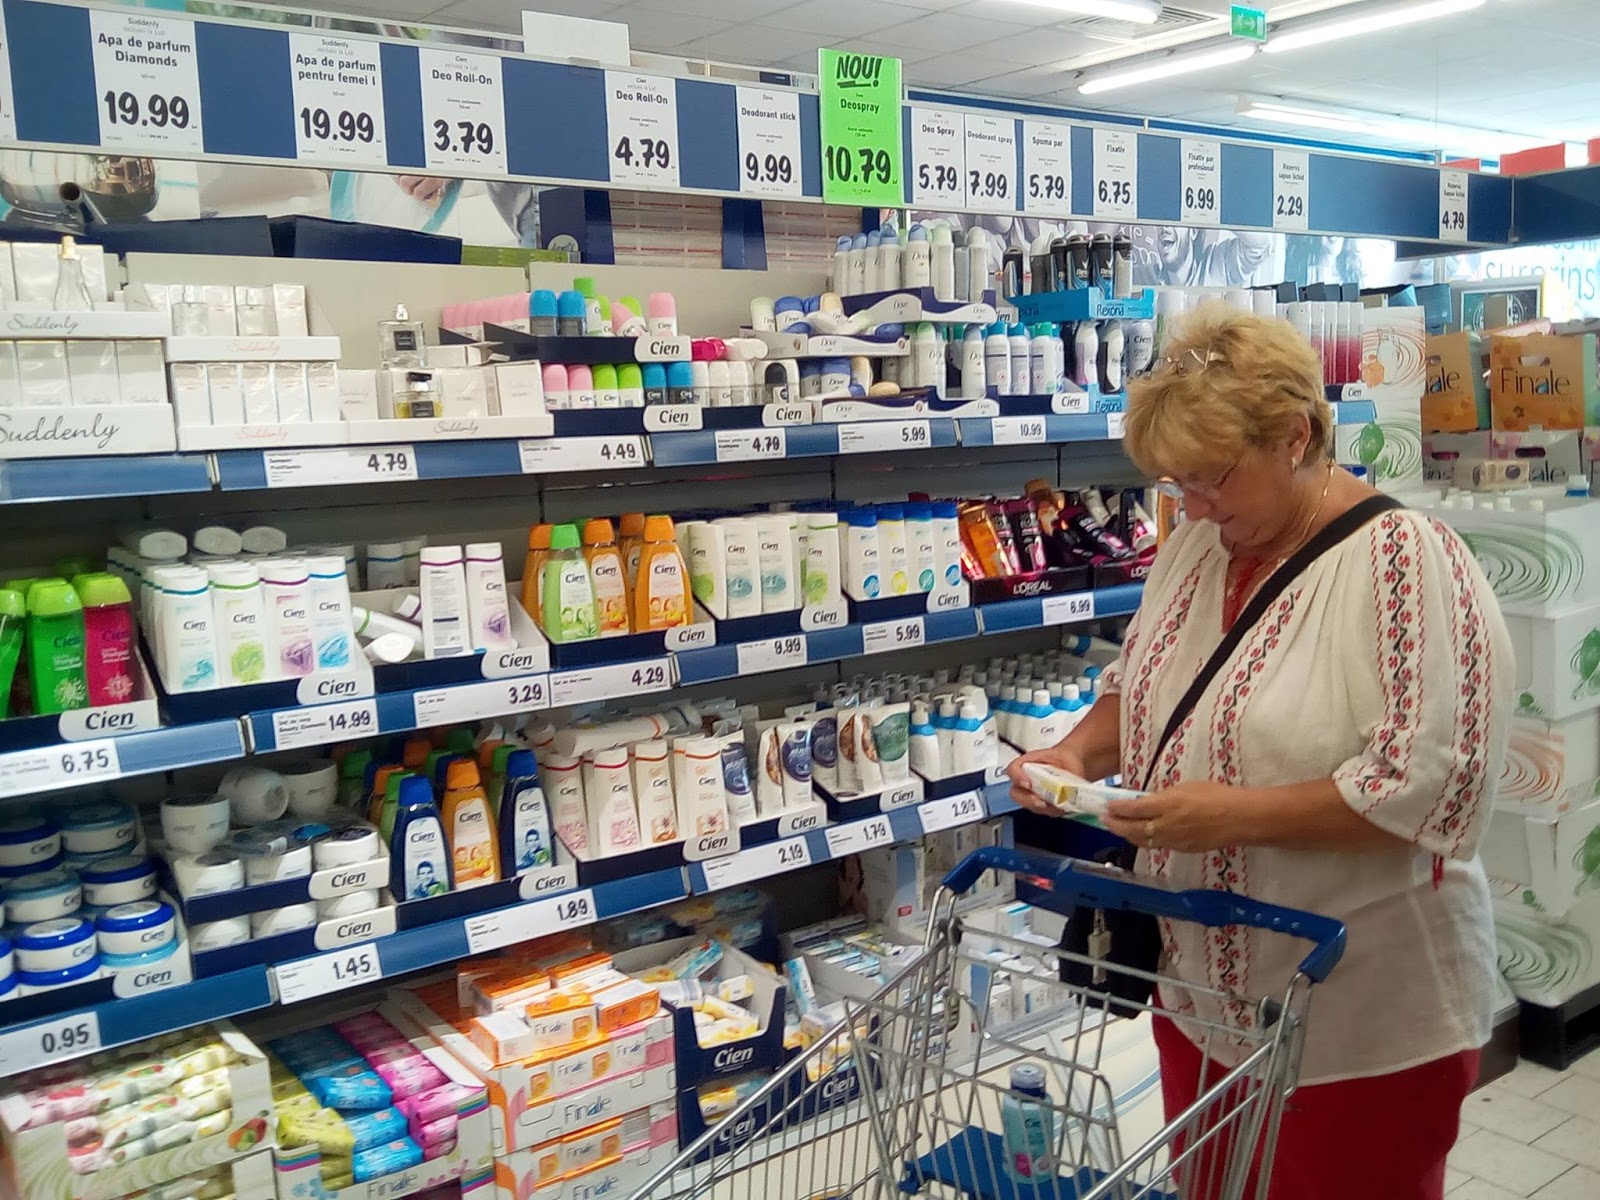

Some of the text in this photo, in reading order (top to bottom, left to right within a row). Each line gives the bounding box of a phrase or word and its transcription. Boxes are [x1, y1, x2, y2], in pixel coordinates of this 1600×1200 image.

[128, 17, 160, 30] Suddenly
[98, 32, 123, 48] Apa
[127, 36, 143, 48] de
[147, 40, 191, 56] parfum
[115, 50, 178, 67] Diamonds
[296, 53, 376, 72] Apa de parfum
[298, 70, 334, 81] pentru
[338, 72, 368, 84] femei
[432, 69, 493, 85] Deo Roll-On
[837, 55, 883, 88] NOU!
[616, 90, 668, 104] Deo Roll-On
[104, 90, 190, 129] 19.99
[741, 107, 796, 121] Deodorant stick
[841, 98, 880, 114] Deospray
[300, 107, 374, 143] 19.99
[922, 124, 955, 137] Deo Spray
[433, 119, 494, 155] 3.79
[967, 131, 996, 141] Deodorant
[615, 136, 670, 169] 4.79
[745, 152, 792, 184] 9.99
[825, 145, 891, 184] 10.79
[918, 163, 957, 191] 5.79
[969, 170, 1008, 199] 7.99
[1029, 174, 1065, 200] 5.79
[1098, 179, 1131, 205] 6.75
[1185, 187, 1214, 211] 6.99
[1276, 194, 1302, 217] 2.29
[1441, 210, 1465, 231] 4.79
[1486, 255, 1595, 301] surins
[996, 311, 1011, 321] ien
[1096, 304, 1124, 319] Rexona
[7, 315, 80, 337] Suddenly
[650, 341, 680, 355] Cien
[820, 338, 836, 346] Dove
[1425, 367, 1460, 396] ale
[1500, 367, 1570, 396] Finale
[1061, 396, 1080, 407] Cien
[659, 408, 689, 424] Cien
[776, 407, 802, 421] Cien
[0, 414, 119, 448] Suddenly
[600, 443, 637, 461] 4.49
[367, 452, 408, 472] 4.79
[728, 543, 745, 554] Cien
[761, 541, 779, 551] Cien
[595, 565, 617, 576] Cien
[653, 563, 676, 575] Cien
[565, 573, 586, 584] Cien
[319, 601, 340, 612] Cien
[937, 594, 959, 607] Cien
[233, 612, 256, 624] Cien
[283, 607, 305, 619] Cien
[813, 611, 837, 625] Cien
[184, 620, 207, 632] Cien
[678, 629, 705, 643] Cien
[499, 653, 533, 669] Cien
[632, 667, 664, 687] 4.29
[317, 680, 356, 696] Cien
[509, 683, 542, 704] 3.29
[85, 710, 134, 729] Cien
[61, 748, 109, 774] 6.75
[891, 791, 914, 804] Cien
[791, 815, 817, 830] Cien
[698, 836, 728, 851] Cien
[331, 872, 366, 887] Cien
[536, 874, 565, 891] Cien
[558, 898, 592, 921] 1.89
[337, 922, 371, 938] Cien
[333, 954, 370, 980] 1.45
[134, 970, 171, 987] Cien
[41, 1024, 89, 1053] 0.95
[714, 1045, 754, 1068] Cien
[823, 1075, 855, 1098] Cien
[720, 1118, 752, 1141] Cen
